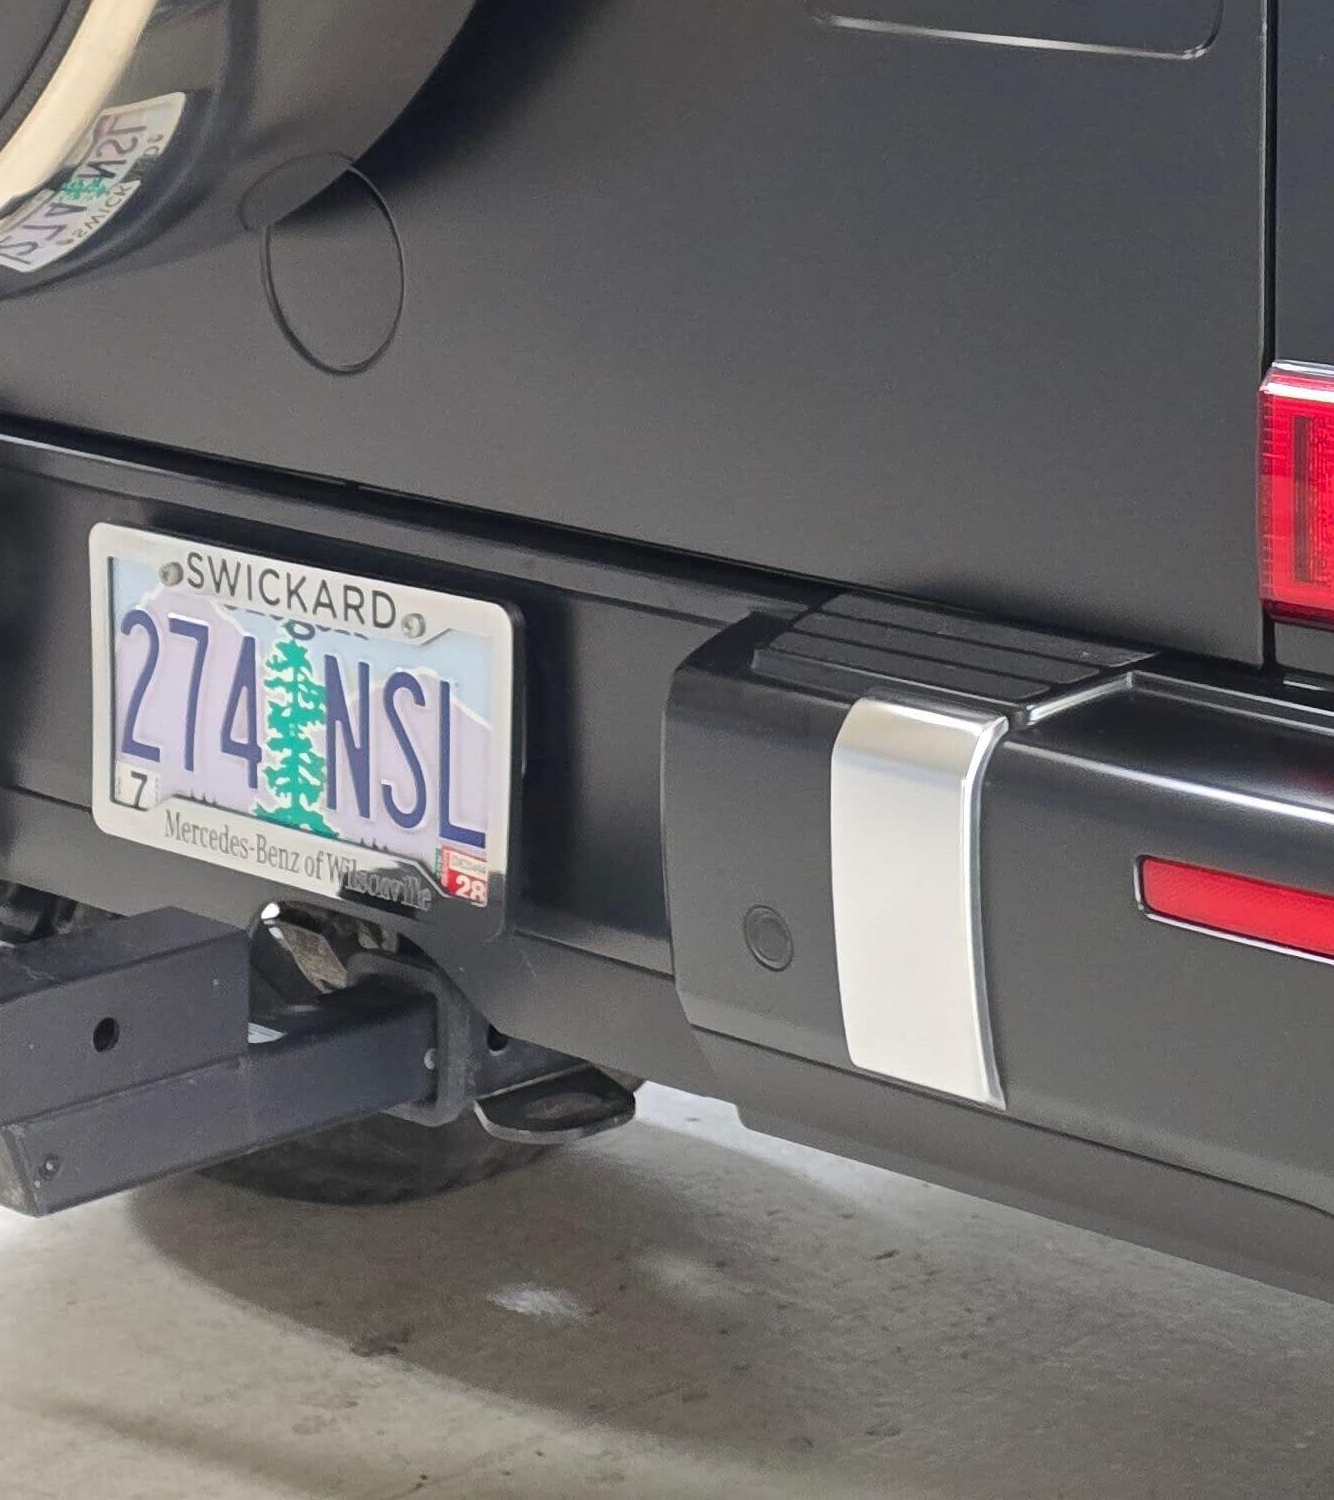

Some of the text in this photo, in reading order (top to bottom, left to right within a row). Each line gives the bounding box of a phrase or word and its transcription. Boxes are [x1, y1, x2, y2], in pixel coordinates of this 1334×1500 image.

[186, 551, 397, 630] SWICKARD
[120, 609, 486, 848] 274 NSL
[130, 768, 148, 808] 7
[164, 808, 300, 875] Mercedes-Benz
[304, 850, 325, 880] of
